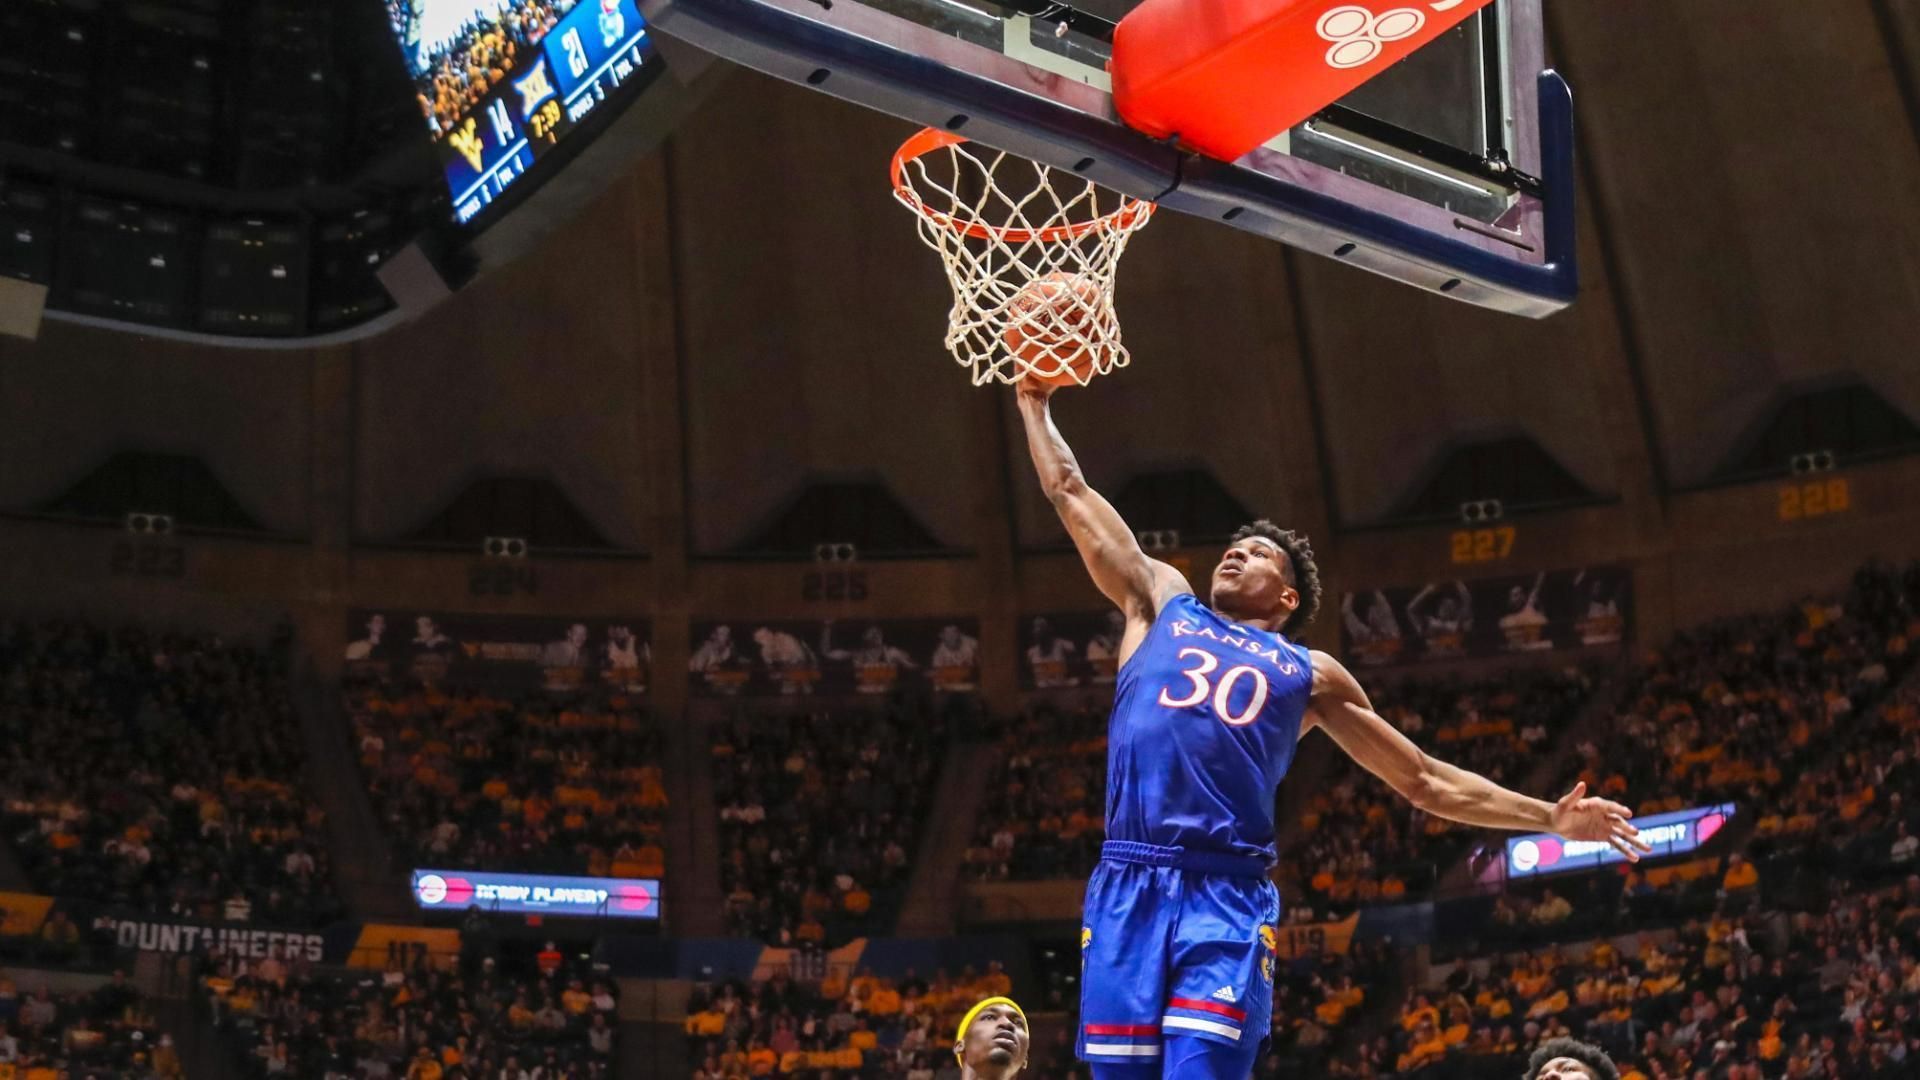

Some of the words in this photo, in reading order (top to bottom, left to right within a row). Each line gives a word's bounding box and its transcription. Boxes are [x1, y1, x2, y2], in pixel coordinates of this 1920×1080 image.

[561, 26, 589, 79] 21
[487, 97, 515, 146] 14
[531, 99, 561, 138] 7:39
[1778, 479, 1848, 519] 228
[1452, 526, 1515, 562] 227
[1171, 620, 1298, 676] KANSAS
[1158, 647, 1269, 726] 30
